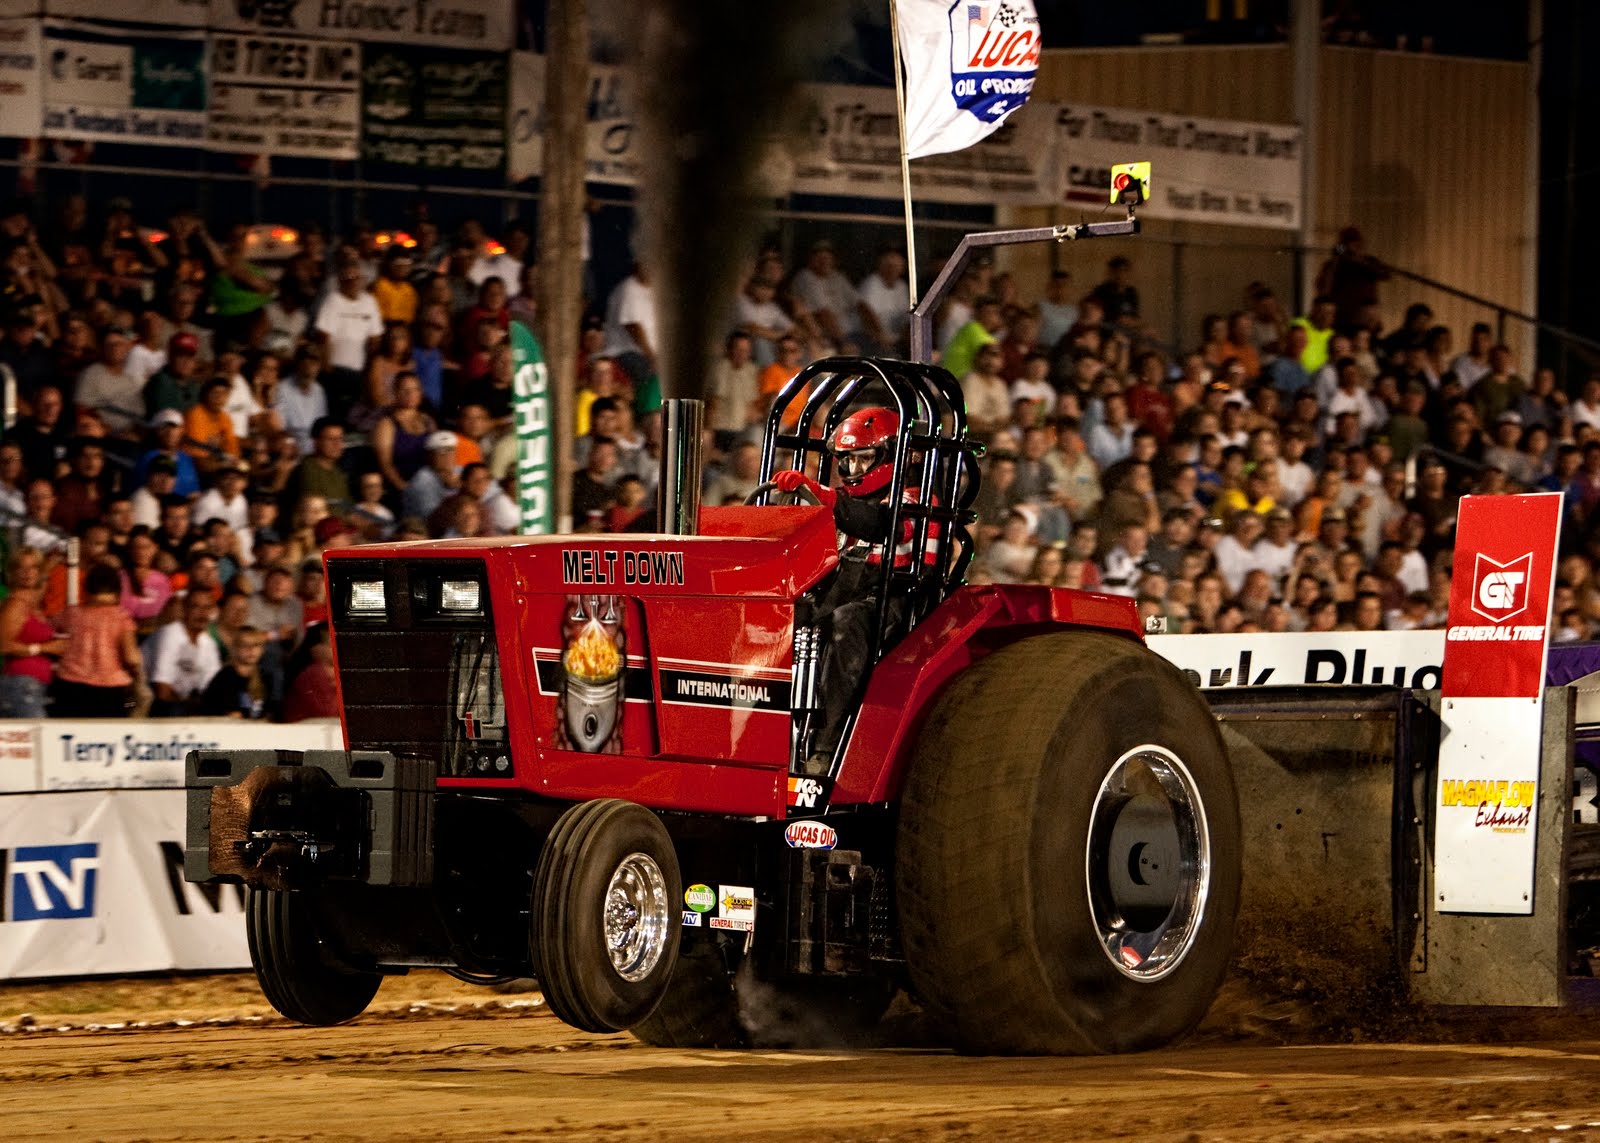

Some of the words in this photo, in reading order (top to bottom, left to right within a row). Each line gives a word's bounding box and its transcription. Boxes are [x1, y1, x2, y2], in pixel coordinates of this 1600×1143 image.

[967, 30, 1042, 68] LUCA
[955, 79, 977, 97] OIL
[562, 550, 618, 585] MELT
[624, 550, 685, 585] DOWN
[1479, 571, 1525, 609] GT
[1447, 625, 1512, 641] GENERAL
[1512, 625, 1545, 641] TIRE
[676, 678, 771, 703] INTERNATIONAL
[60, 734, 117, 768] Terry
[1441, 779, 1536, 808] MAGNAFLOW
[1475, 800, 1532, 828] Exhaust
[789, 825, 819, 844] LUCAS
[820, 828, 835, 846] OIL
[11, 857, 101, 911] TV
[688, 892, 713, 902] CANIDAE
[711, 918, 733, 928] GENERAL
[734, 920, 744, 929] TIRE
